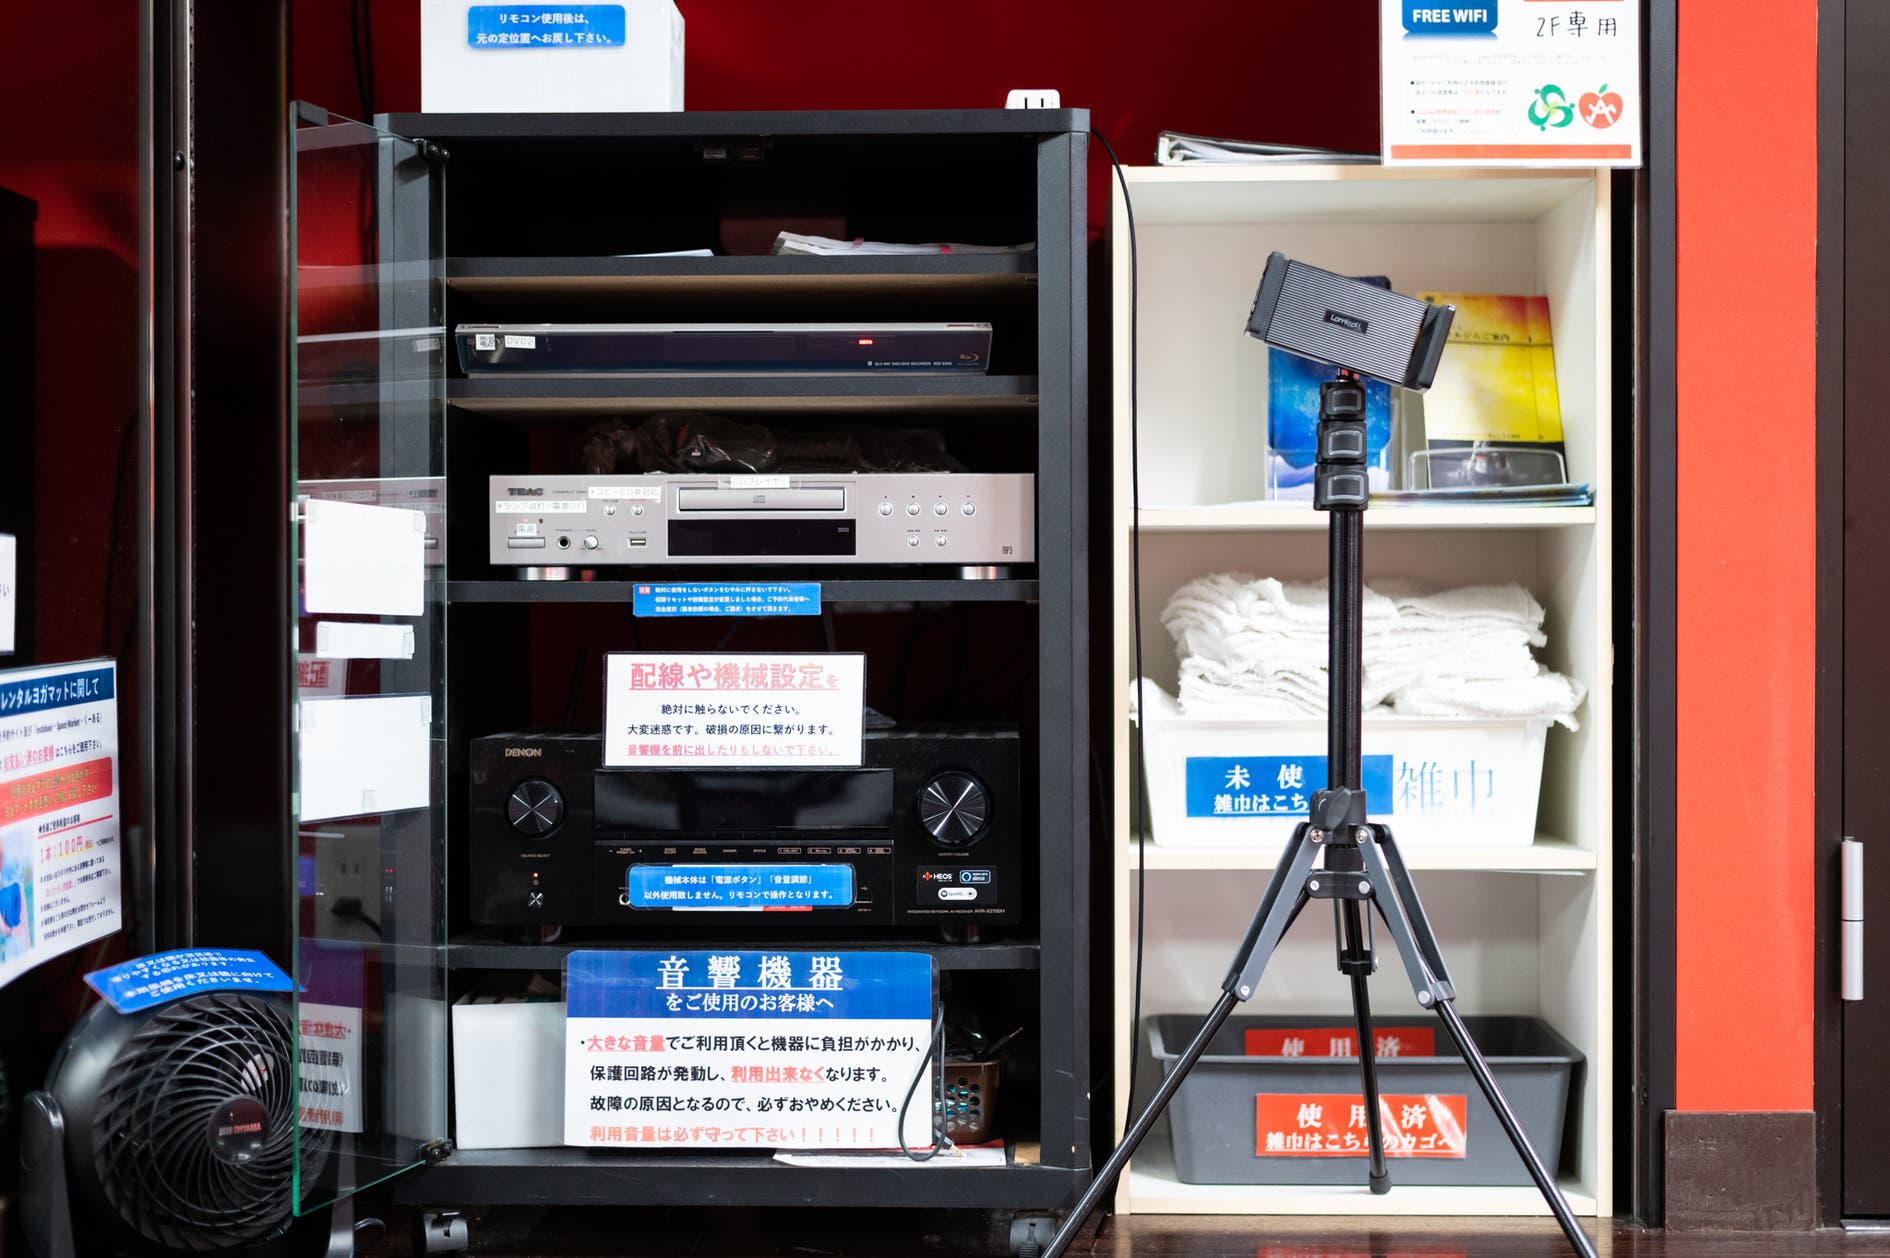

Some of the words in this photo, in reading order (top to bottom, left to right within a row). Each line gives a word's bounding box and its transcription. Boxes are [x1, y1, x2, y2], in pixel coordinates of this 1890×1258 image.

[499, 13, 591, 24] リモコン使用後は、
[1413, 9, 1450, 23] FREE
[1452, 9, 1488, 23] WIFI
[1536, 11, 1617, 37] 2F専用
[476, 32, 613, 45] 元の定位置へお戻し下さい。
[507, 488, 544, 496] TEAC
[630, 662, 840, 690] 配線や機械設定を
[1, 678, 99, 710] レンタルヨガマットに関して
[661, 704, 801, 716] 絶対に触らないでください。
[627, 724, 835, 736] 大変迷惑です。破損の原因に繋がります。
[505, 748, 542, 758] DENON
[627, 744, 835, 756] 音響棚を前に出したりもしないで下さい。
[1225, 765, 1303, 789] 未使
[1395, 759, 1495, 812] 雑巾
[1213, 794, 1310, 813] 雑巾はこち
[664, 875, 813, 885] 機械本体は「電源ボタン」「音量調節」
[643, 890, 834, 900] 以外使用致しません。リモコンで操作となります。
[656, 954, 844, 991] 音響機器
[666, 993, 834, 1012] をご使用のお客様へ
[589, 1065, 888, 1083] 保護回路が発動し、利用出来なくなります。
[589, 1096, 898, 1112] 故障の原因となるので、必ずおやめください。
